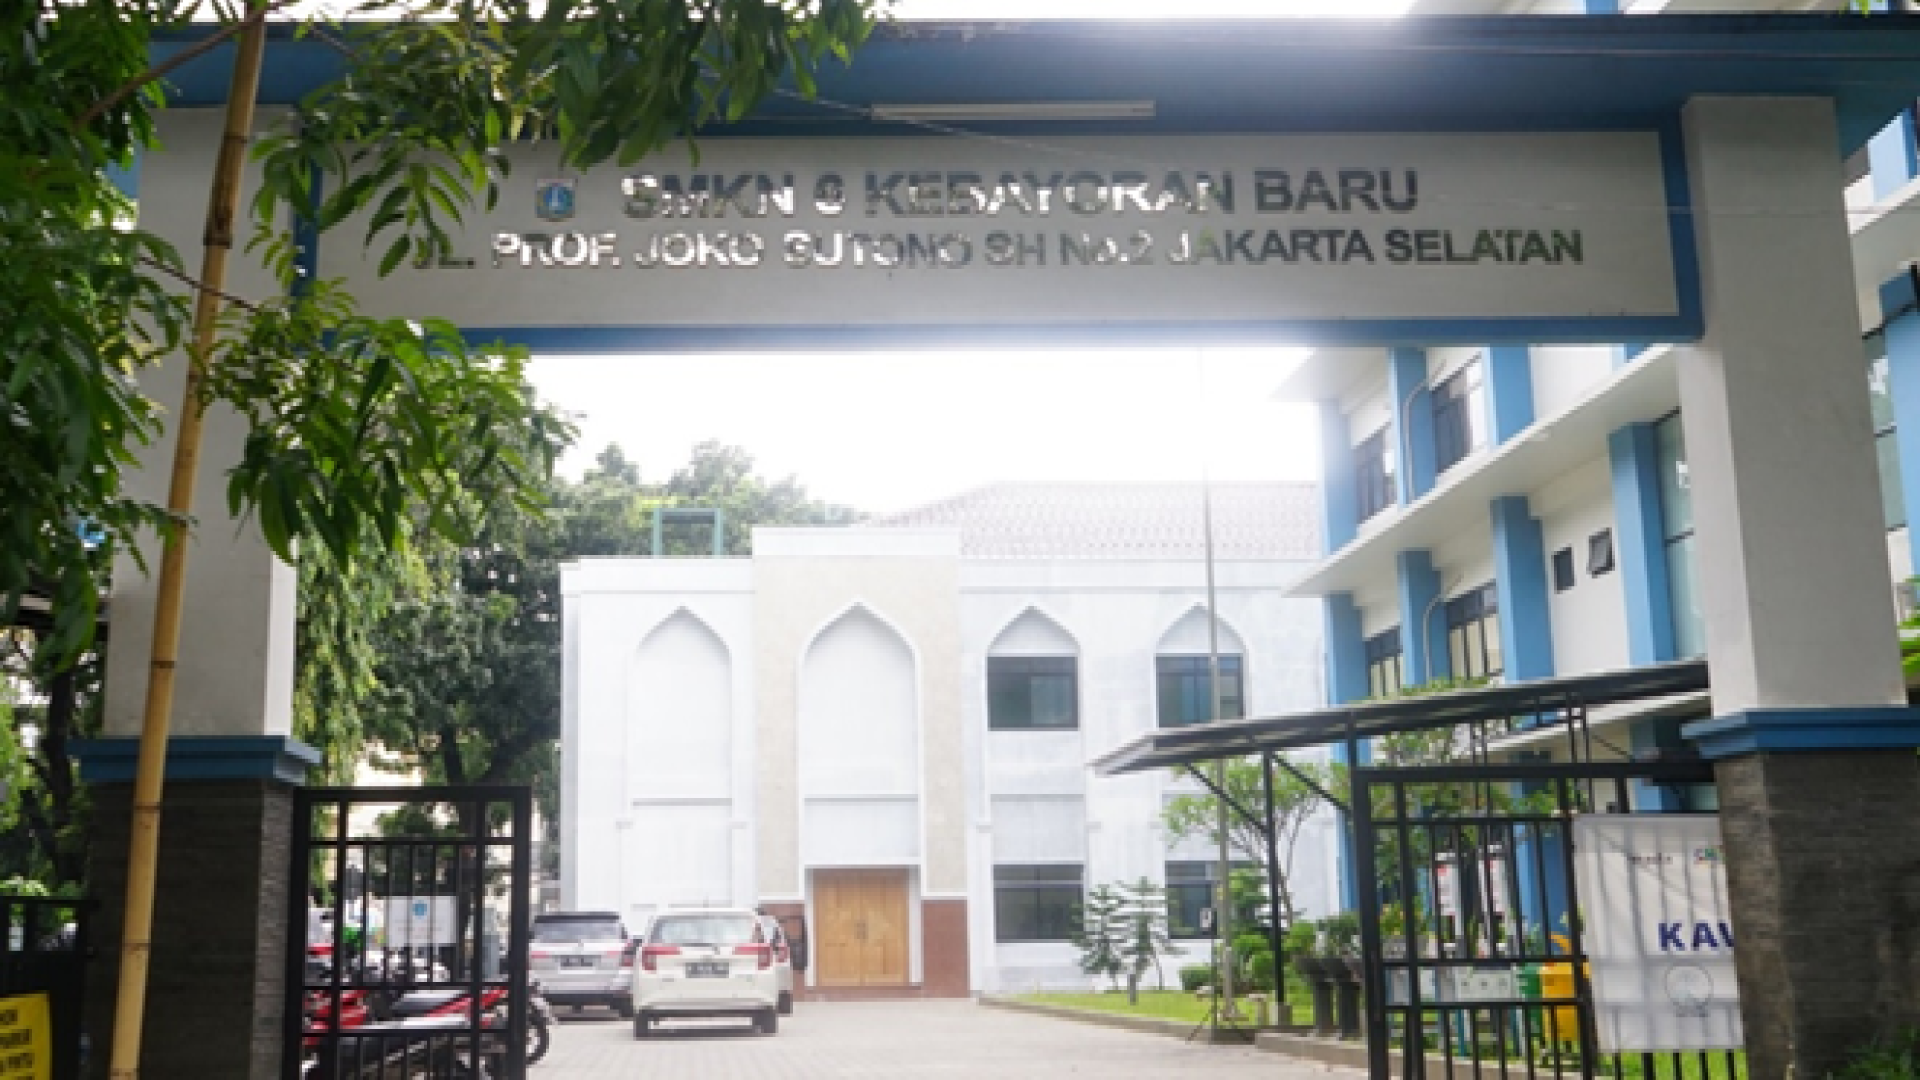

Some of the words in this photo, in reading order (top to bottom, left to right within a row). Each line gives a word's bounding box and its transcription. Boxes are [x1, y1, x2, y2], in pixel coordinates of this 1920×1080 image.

[620, 173, 796, 218] SMKN
[864, 170, 1234, 216] KEBAYORAN
[1253, 167, 1419, 214] BARU
[491, 231, 622, 267] PROF.
[634, 231, 765, 267] JOKO
[782, 231, 973, 266] SUTONO
[983, 231, 1046, 266] SH
[1165, 229, 1376, 264] JAKARTA
[1384, 228, 1583, 264] SELATAN
